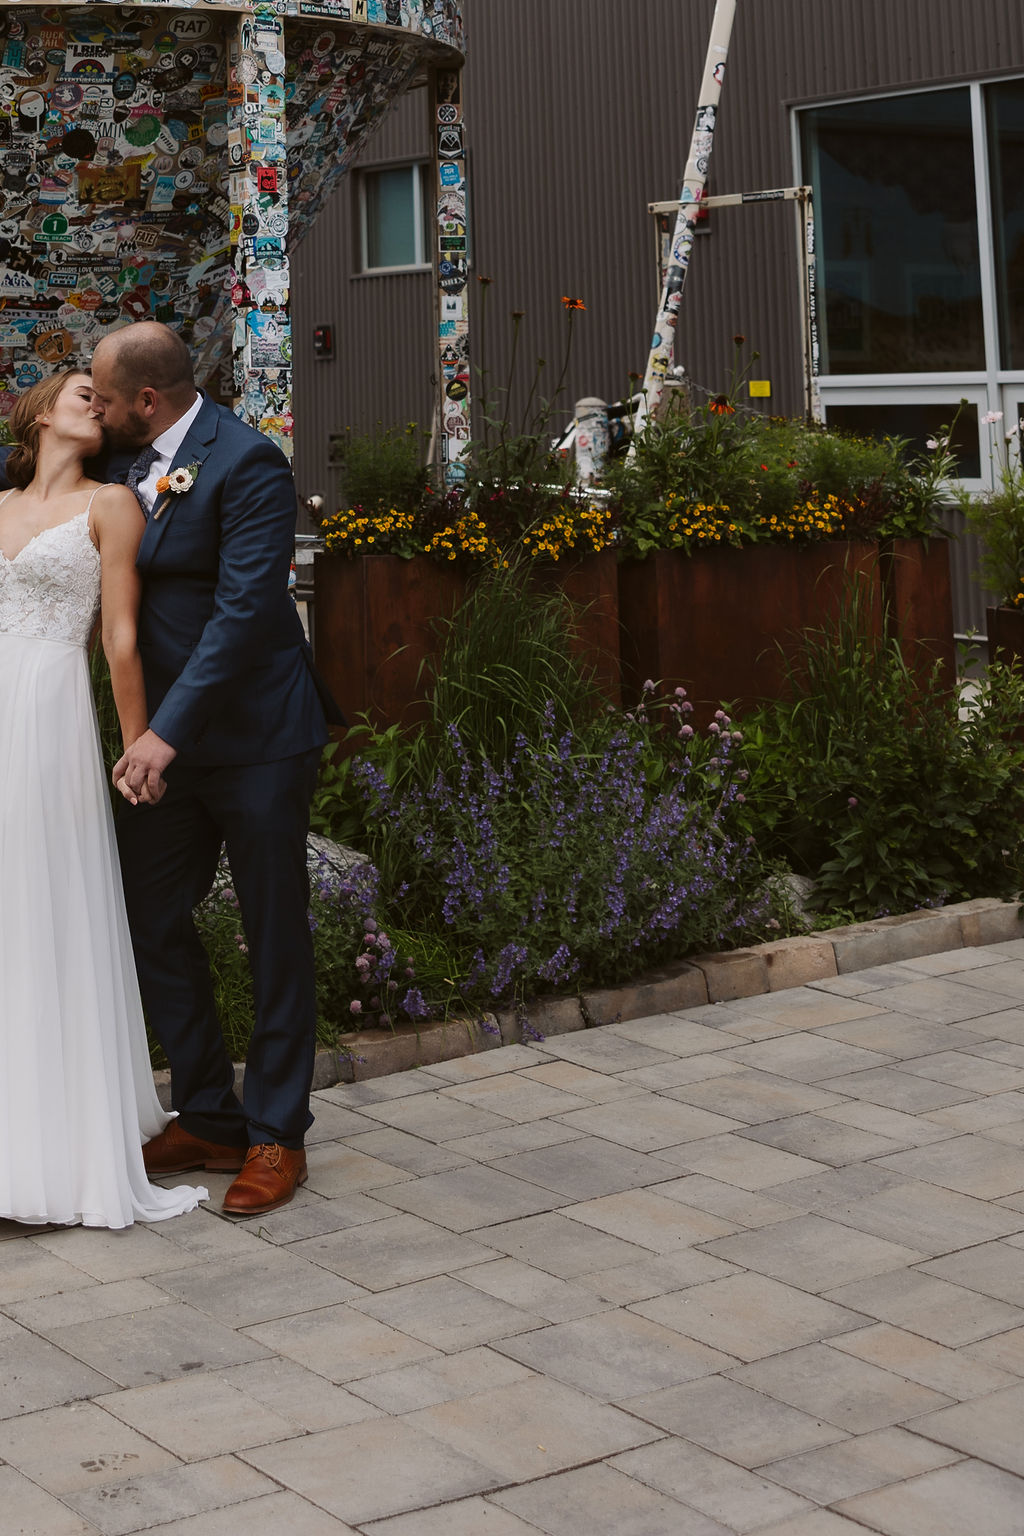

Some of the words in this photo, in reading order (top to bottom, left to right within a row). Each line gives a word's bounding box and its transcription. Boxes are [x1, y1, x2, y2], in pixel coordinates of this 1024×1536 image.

[175, 20, 206, 33] RAT
[40, 31, 64, 39] BUCK
[136, 231, 154, 244] FATE
